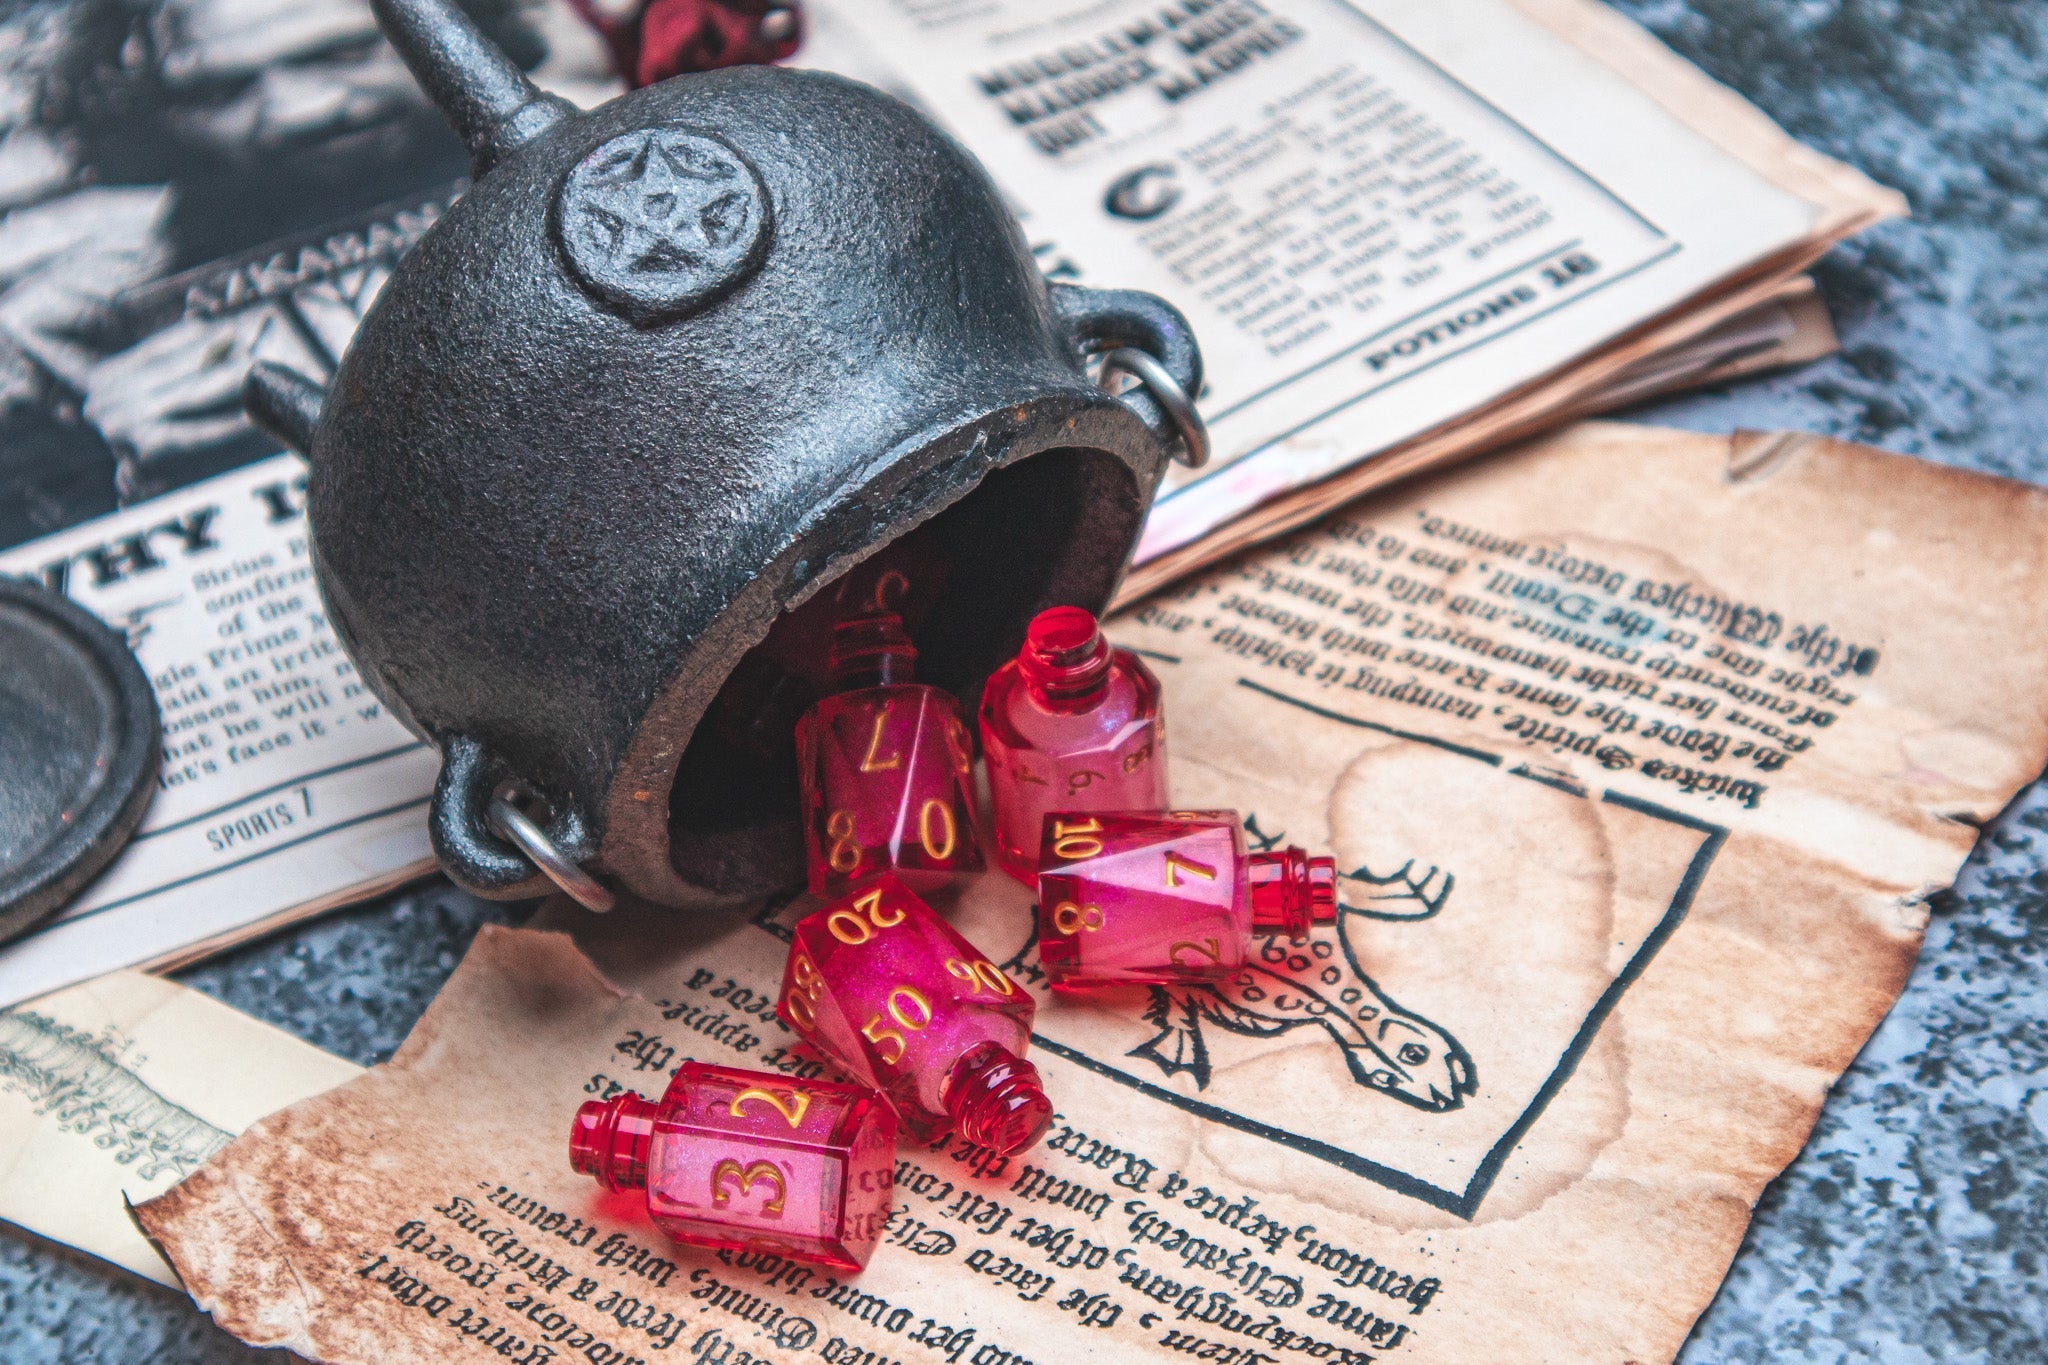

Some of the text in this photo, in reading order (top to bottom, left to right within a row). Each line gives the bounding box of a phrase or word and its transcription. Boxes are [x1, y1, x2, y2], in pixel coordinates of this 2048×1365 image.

[1365, 284, 1537, 371] POTIONS
[193, 555, 275, 590] Sirius
[218, 613, 245, 636] of
[258, 596, 303, 621] the
[1342, 599, 1393, 628] the
[1602, 608, 1654, 637] the
[153, 664, 197, 692] gle
[208, 627, 298, 669] Prime
[165, 684, 209, 711] aid
[224, 670, 260, 690] an
[159, 735, 206, 766] hat
[222, 718, 261, 739] he
[273, 689, 330, 720] will
[1584, 703, 1638, 734] the
[227, 732, 292, 764] face
[300, 720, 326, 739] it
[206, 788, 315, 852] SPORTS 7
[826, 810, 862, 872] 8
[919, 799, 956, 860] 0
[1054, 818, 1104, 859] 10
[828, 889, 906, 944] 20
[1054, 901, 1104, 936] 8
[861, 985, 932, 1066] 50
[729, 1088, 811, 1129] 2
[711, 1159, 788, 1220] 3
[1157, 1170, 1185, 1198] a
[596, 1232, 684, 1288] with
[567, 1277, 599, 1302] a
[1057, 1288, 1123, 1329] the
[908, 1319, 976, 1364] her
